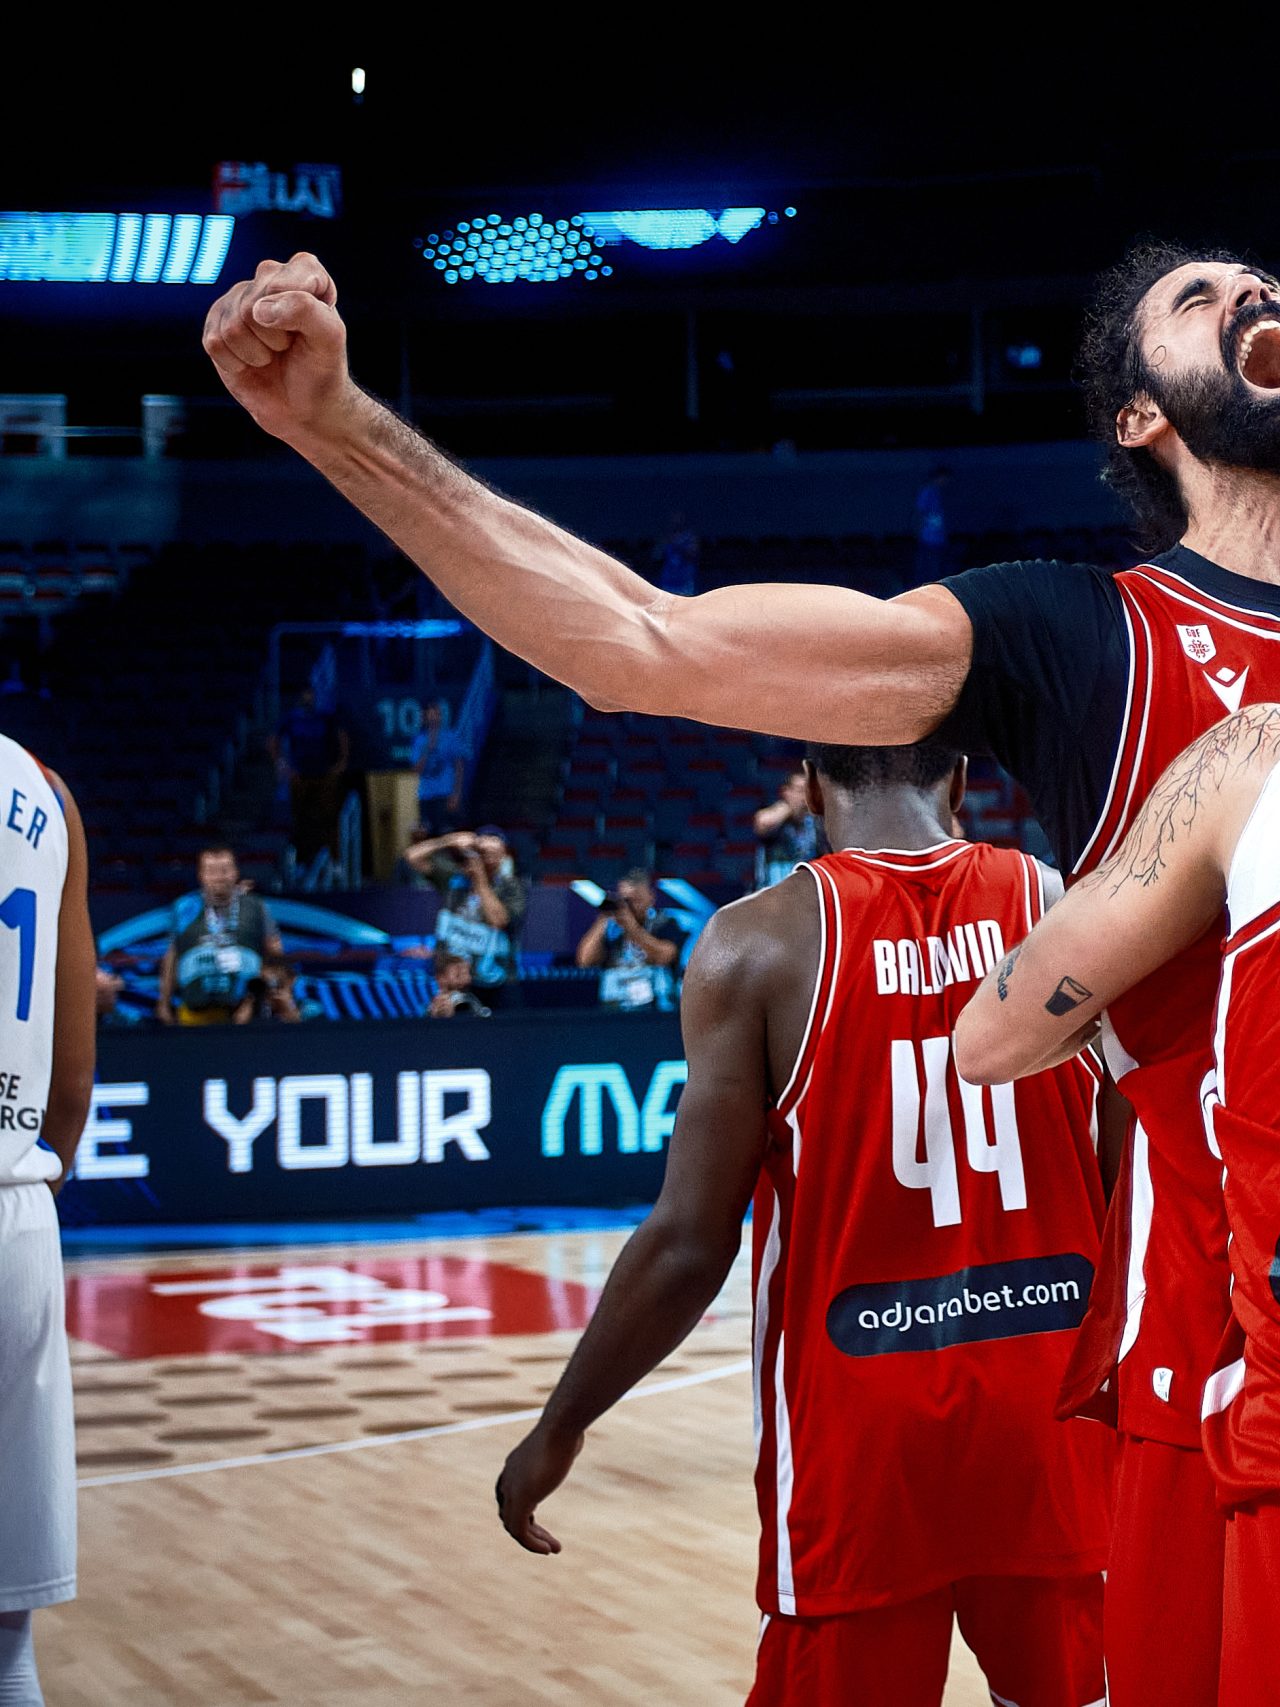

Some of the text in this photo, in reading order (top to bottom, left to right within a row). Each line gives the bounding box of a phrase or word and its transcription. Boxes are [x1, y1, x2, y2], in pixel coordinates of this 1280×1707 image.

[0, 787, 48, 850] ER
[872, 919, 1006, 996] BALDWIN
[202, 1067, 492, 1174] YOUR
[890, 1035, 1028, 1229] 44
[857, 1276, 1081, 1333] adjarabet.com
